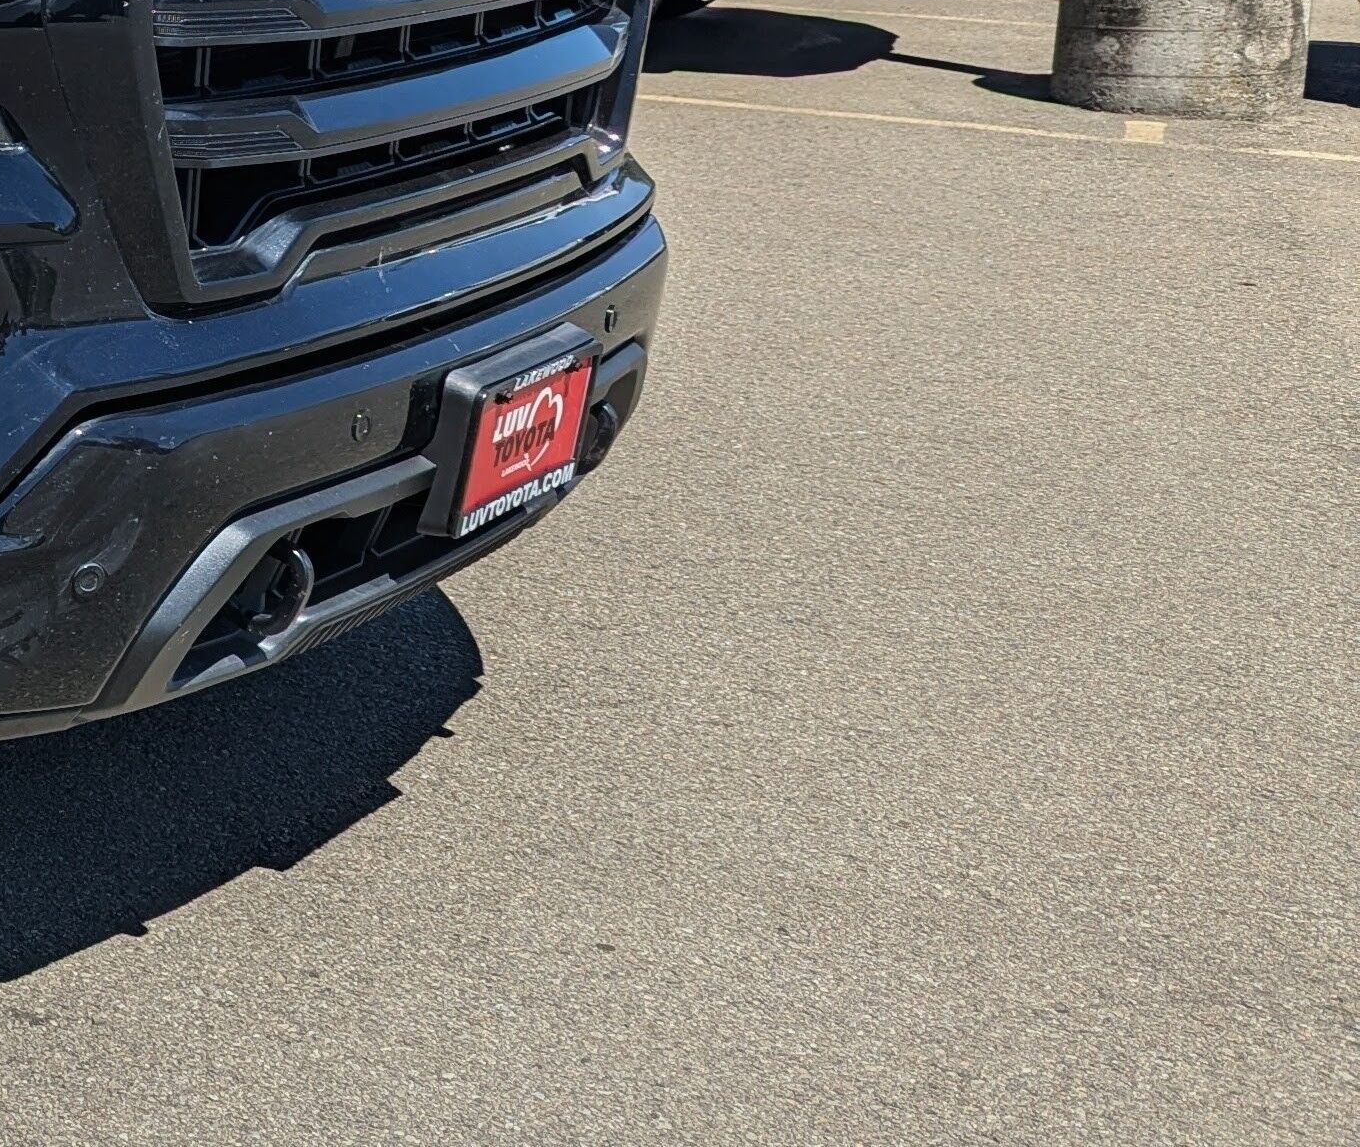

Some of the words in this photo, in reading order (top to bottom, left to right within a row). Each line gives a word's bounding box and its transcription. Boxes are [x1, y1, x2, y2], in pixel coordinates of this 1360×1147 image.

[493, 403, 532, 443] LUV
[493, 417, 556, 467] TOYOTA
[460, 462, 575, 537] LUVTOYOTA.COM
